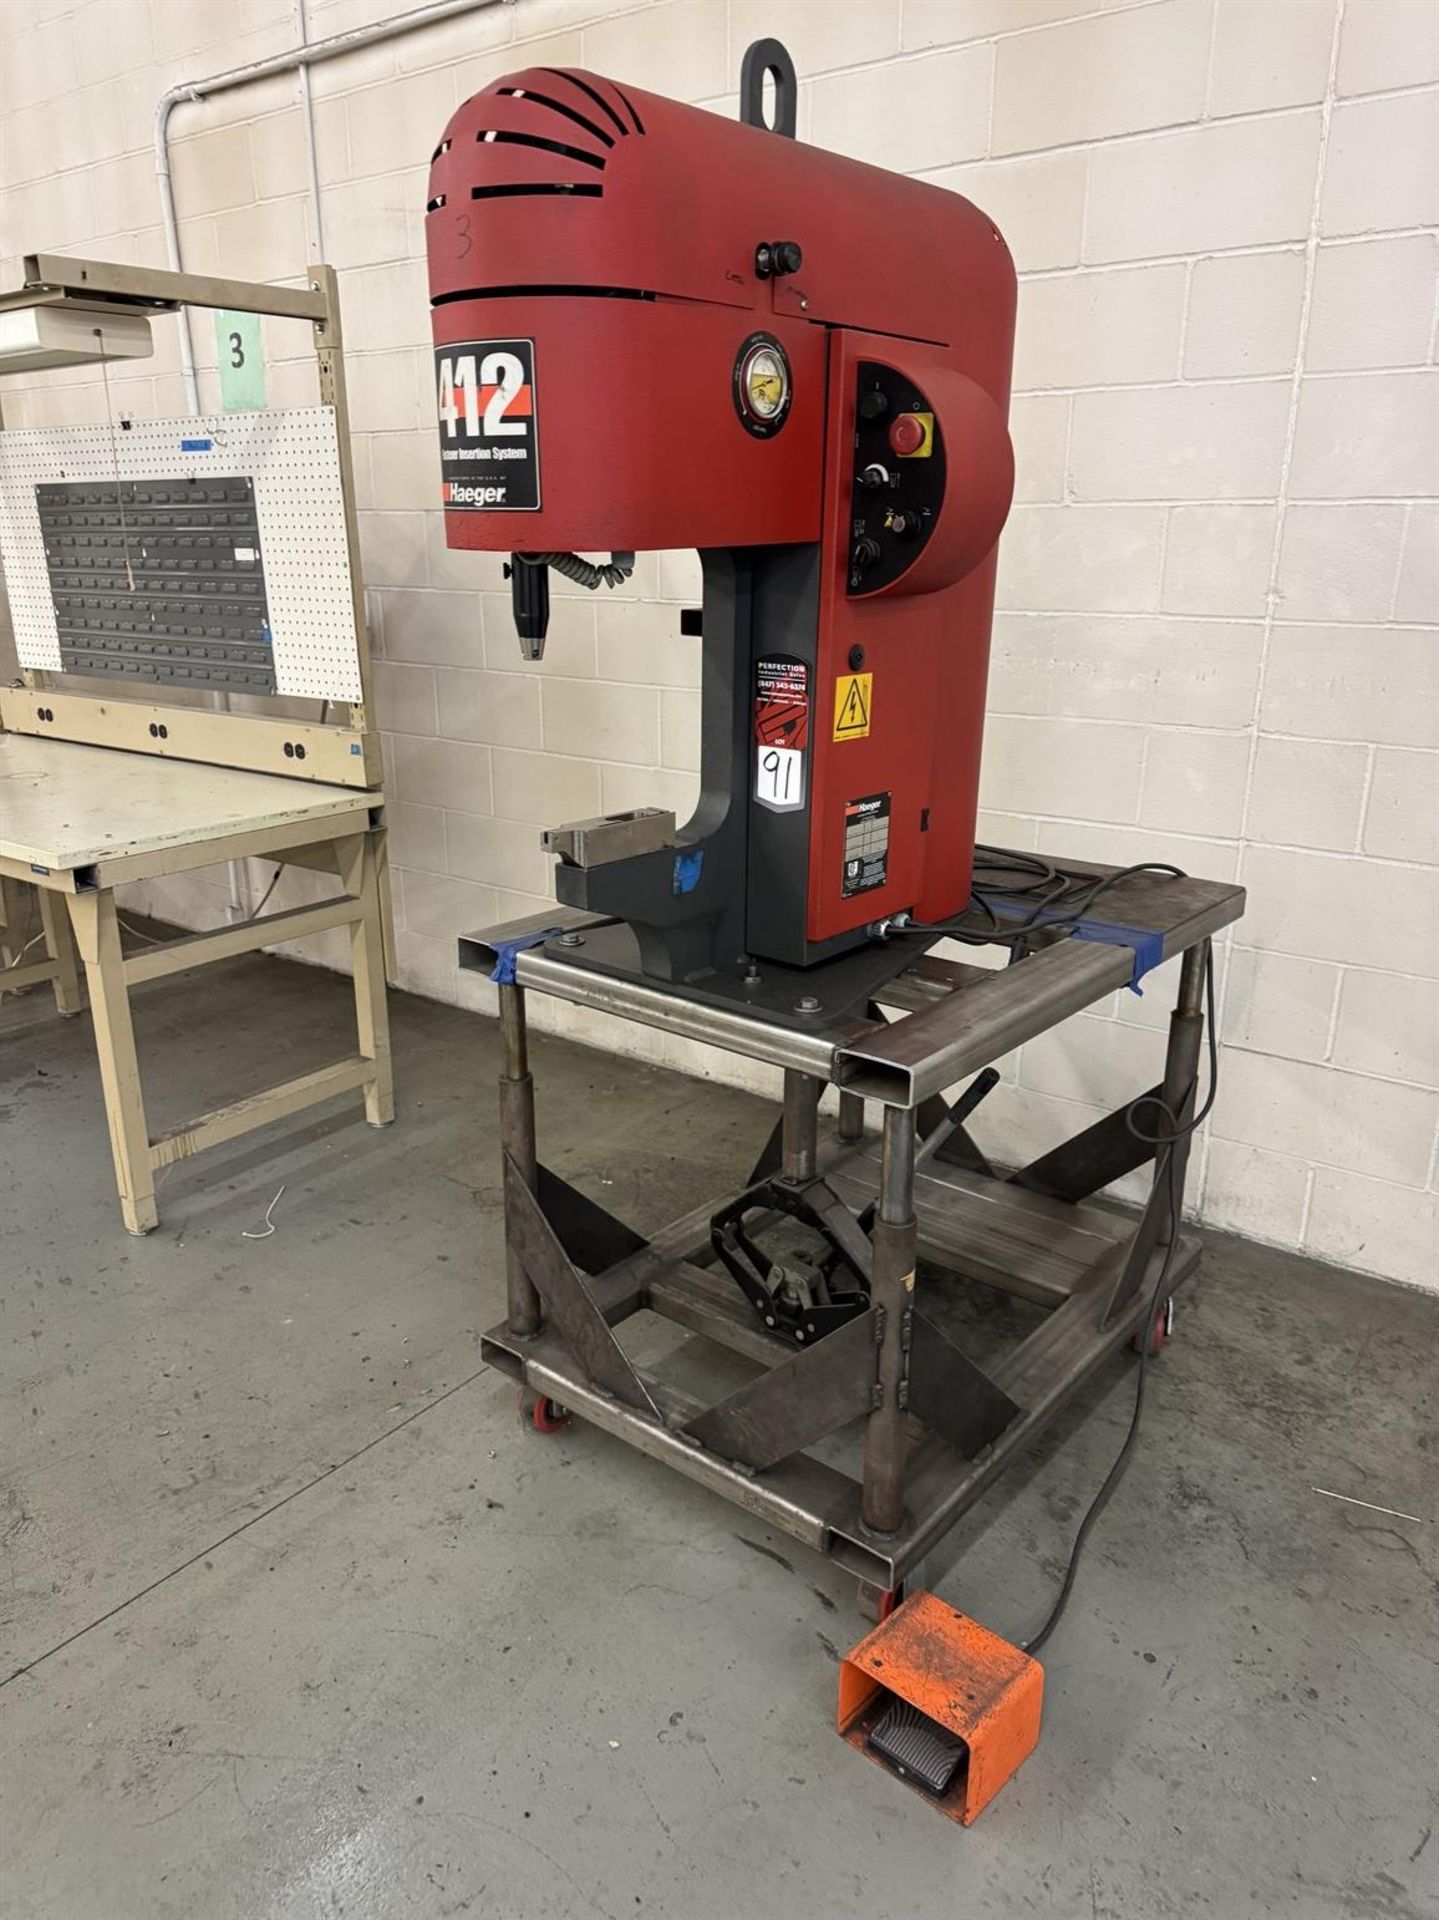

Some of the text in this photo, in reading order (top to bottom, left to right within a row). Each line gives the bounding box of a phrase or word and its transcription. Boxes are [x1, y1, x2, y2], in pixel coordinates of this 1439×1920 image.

[456, 214, 472, 259] 3
[229, 332, 245, 369] 3
[439, 352, 528, 437] 412
[459, 447, 492, 460] Insertion
[492, 446, 528, 460] System
[450, 482, 507, 506] Haeger
[758, 662, 806, 672] PERFECTION
[763, 751, 792, 800] 91
